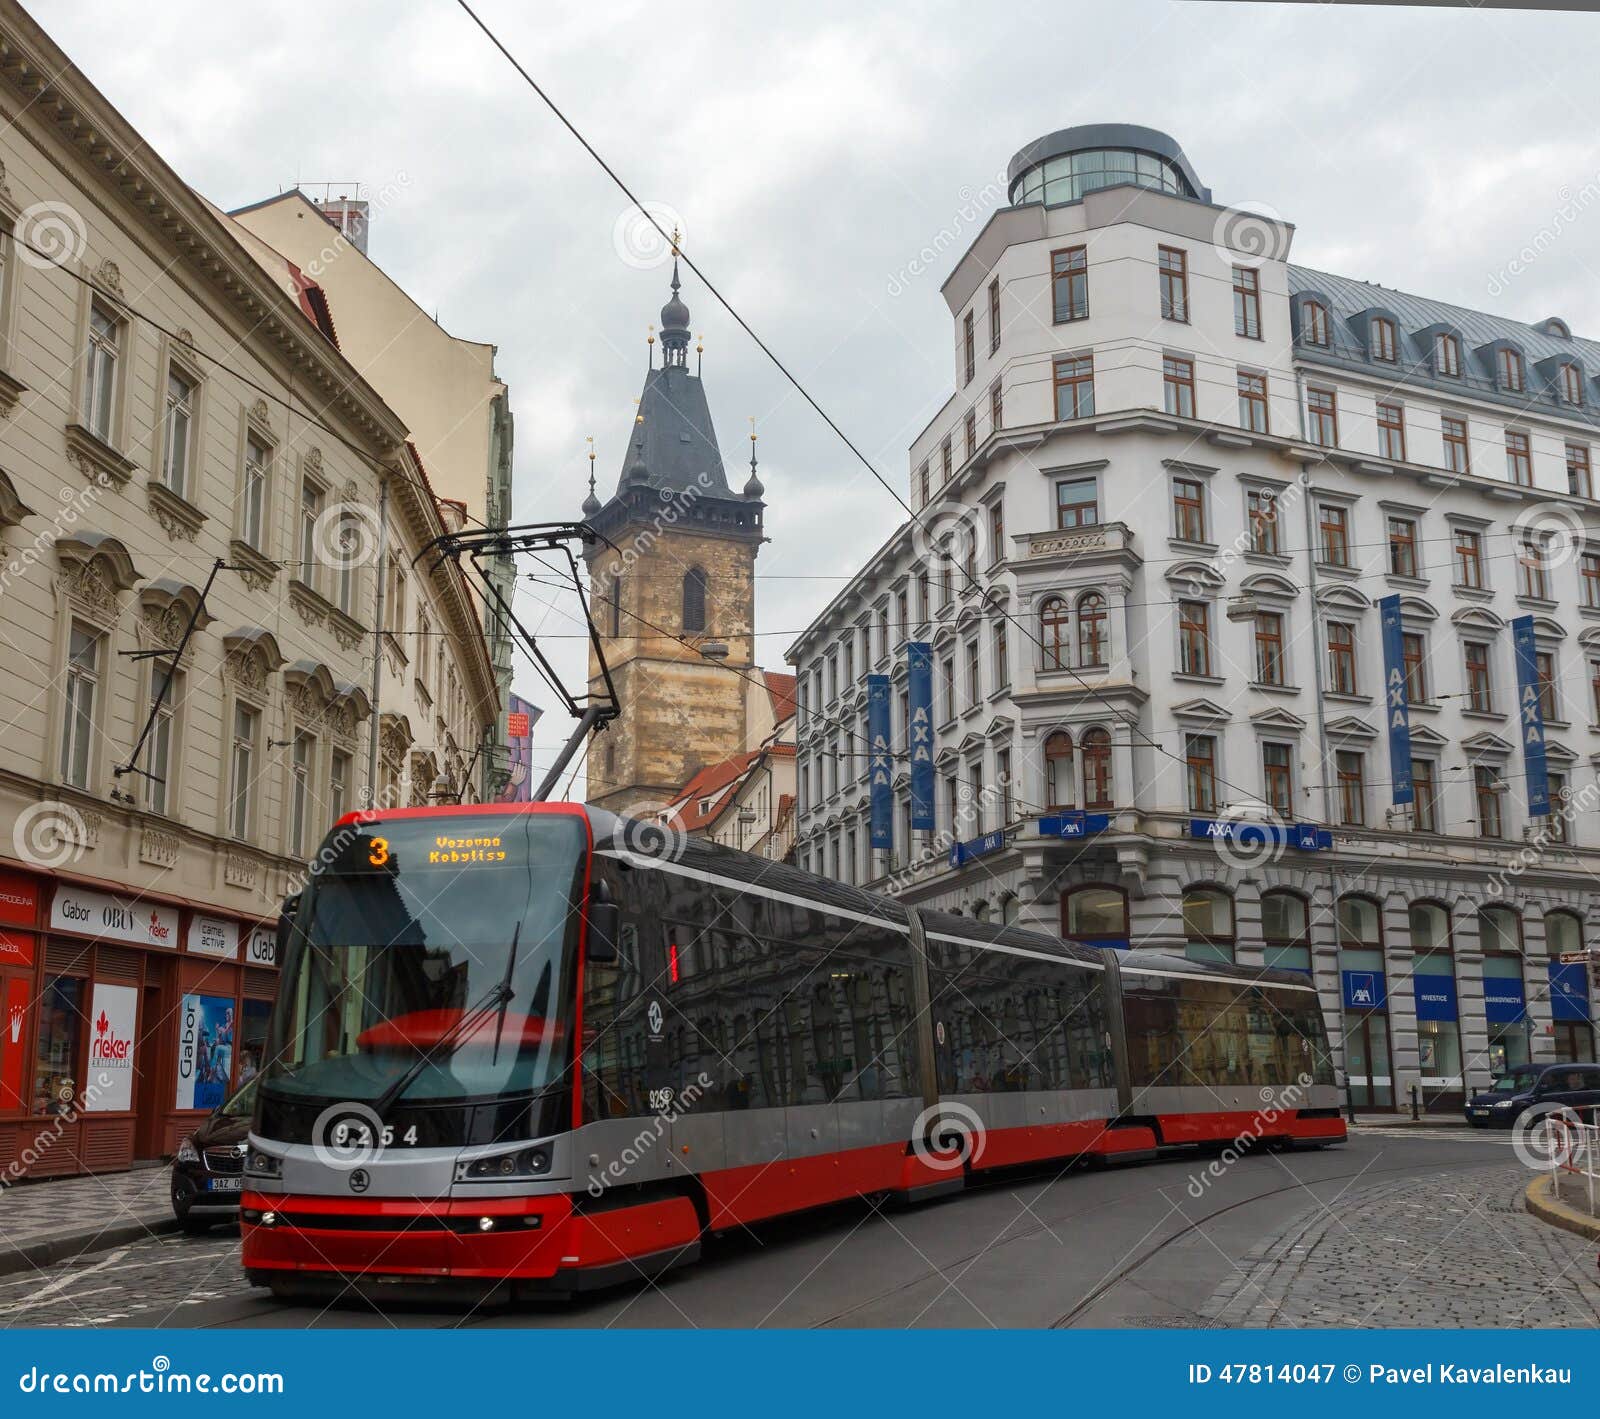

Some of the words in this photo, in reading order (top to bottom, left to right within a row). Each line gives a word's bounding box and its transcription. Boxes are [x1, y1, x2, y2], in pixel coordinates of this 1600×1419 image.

[1389, 667, 1406, 729] AXA
[1522, 685, 1541, 744] AXA
[912, 706, 930, 761] AXA
[873, 734, 888, 785] AXA
[1206, 823, 1233, 837] AXA
[368, 837, 390, 867] 3
[436, 837, 501, 849] Vozovna
[984, 835, 996, 850] AXA
[429, 850, 507, 864] Kobylisy
[62, 899, 91, 922] Gabor
[148, 922, 169, 939] rieker
[202, 924, 225, 938] camel
[201, 937, 225, 949] active
[252, 931, 276, 962] Gab
[92, 1030, 131, 1059] rieker
[180, 1002, 195, 1079] Gabor
[335, 1124, 418, 1145] 9254
